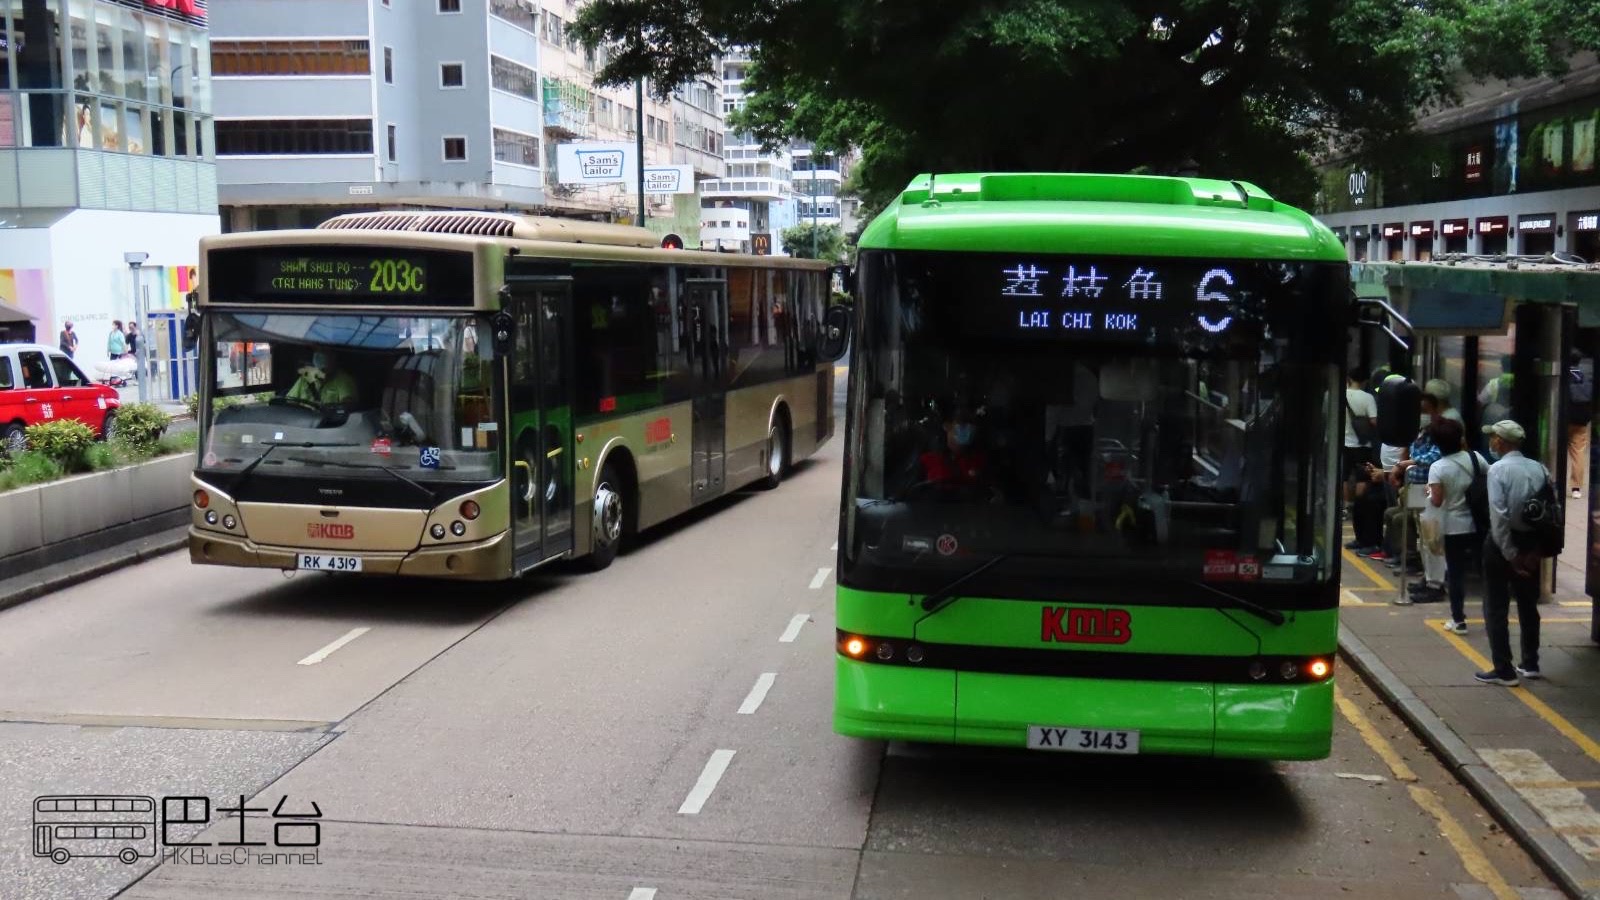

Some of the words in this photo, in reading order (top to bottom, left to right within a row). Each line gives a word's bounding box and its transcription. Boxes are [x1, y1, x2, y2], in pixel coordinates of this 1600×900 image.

[589, 155, 618, 165] Sam's
[584, 163, 613, 175] tailor
[651, 173, 676, 181] Sam's
[280, 260, 307, 273] SHAM
[309, 260, 334, 273] SHUI
[337, 261, 350, 274] PO
[299, 277, 324, 289] HANG
[1019, 311, 1050, 328] LAI
[1062, 313, 1092, 329] CHI
[1105, 313, 1138, 330] KOK
[320, 523, 354, 540] KMB
[304, 556, 320, 571] RK
[328, 557, 357, 571] 4319
[1042, 607, 1132, 644] KMB
[1040, 729, 1067, 746] XY
[1080, 731, 1128, 750] 3143
